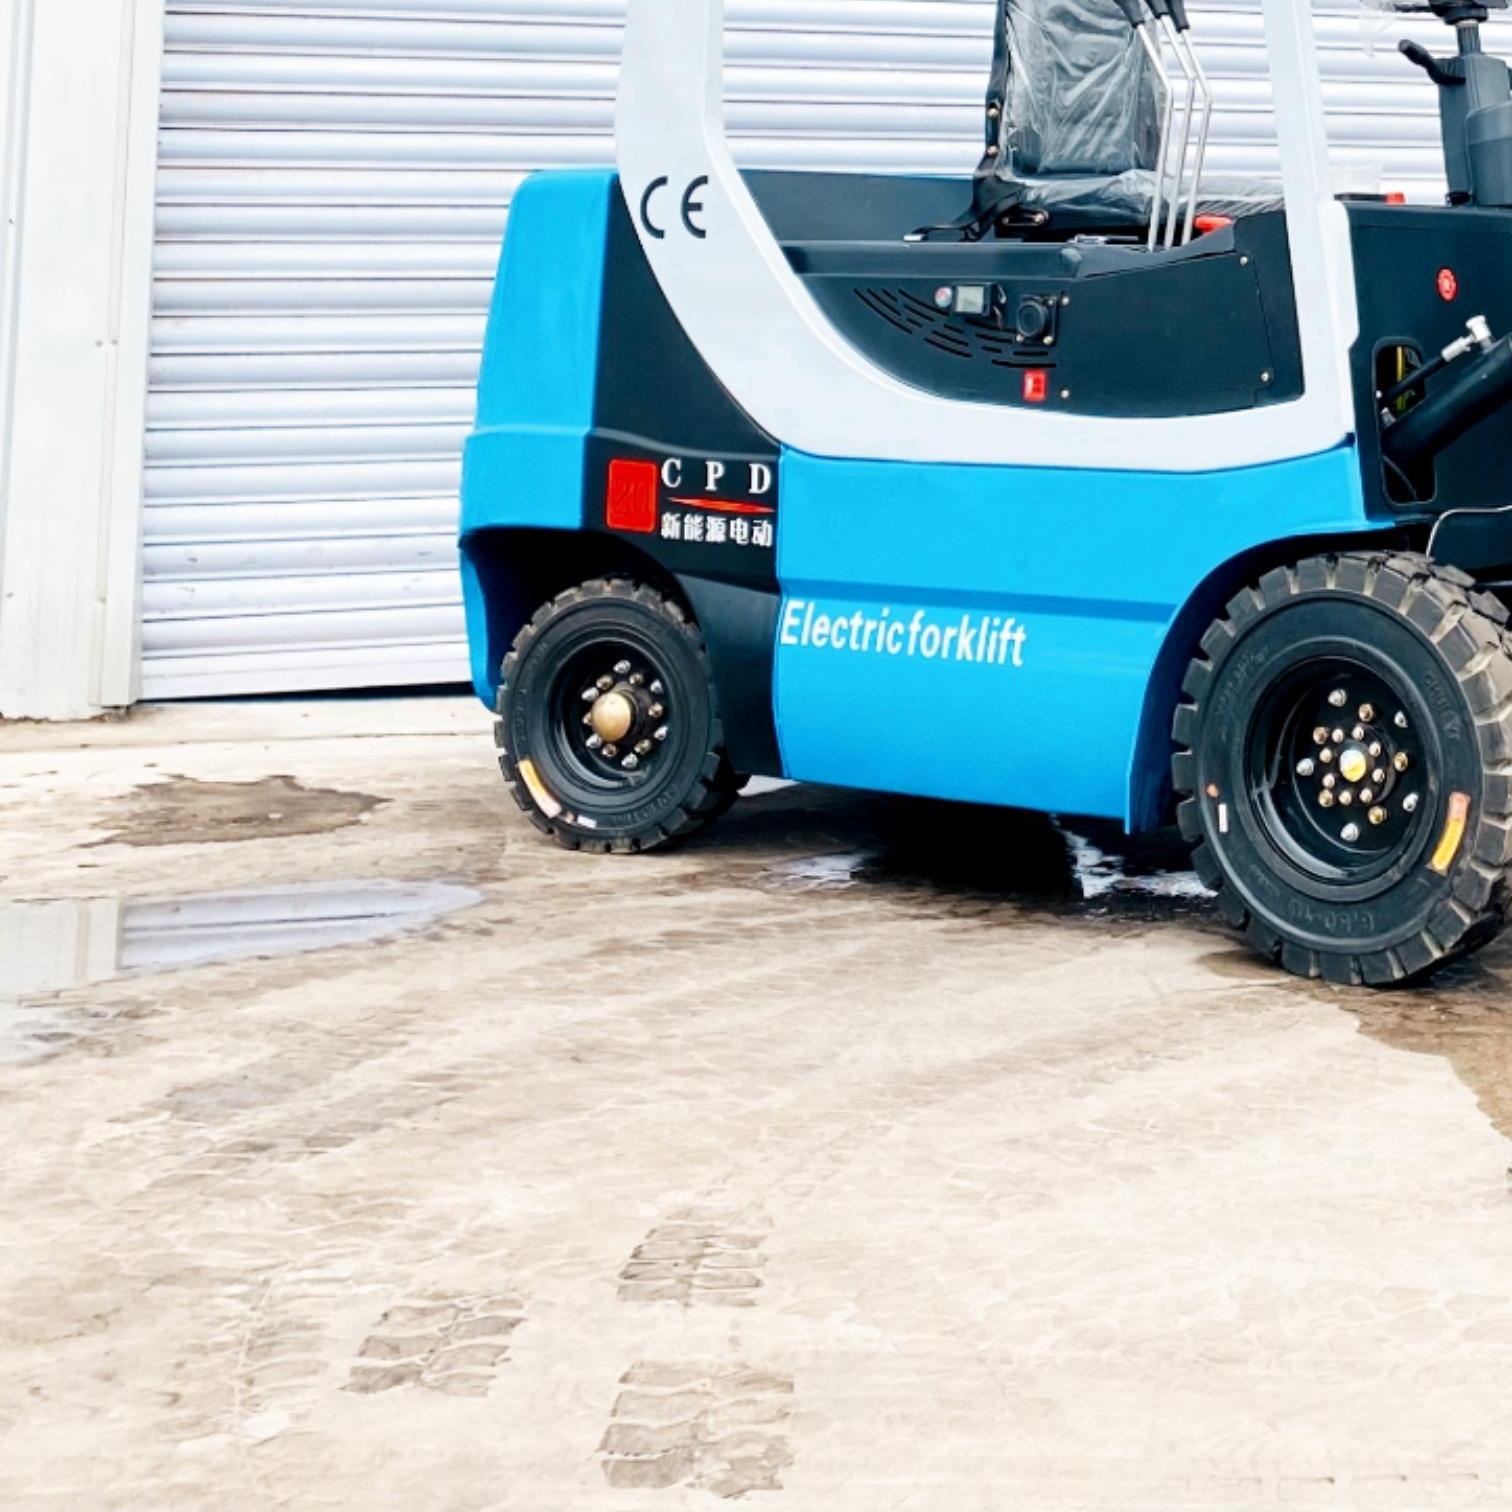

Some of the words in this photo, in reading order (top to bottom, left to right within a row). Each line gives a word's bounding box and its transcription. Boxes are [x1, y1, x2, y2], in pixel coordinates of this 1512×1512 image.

[640, 175, 708, 239] CE
[661, 512, 773, 547] 新能源电动
